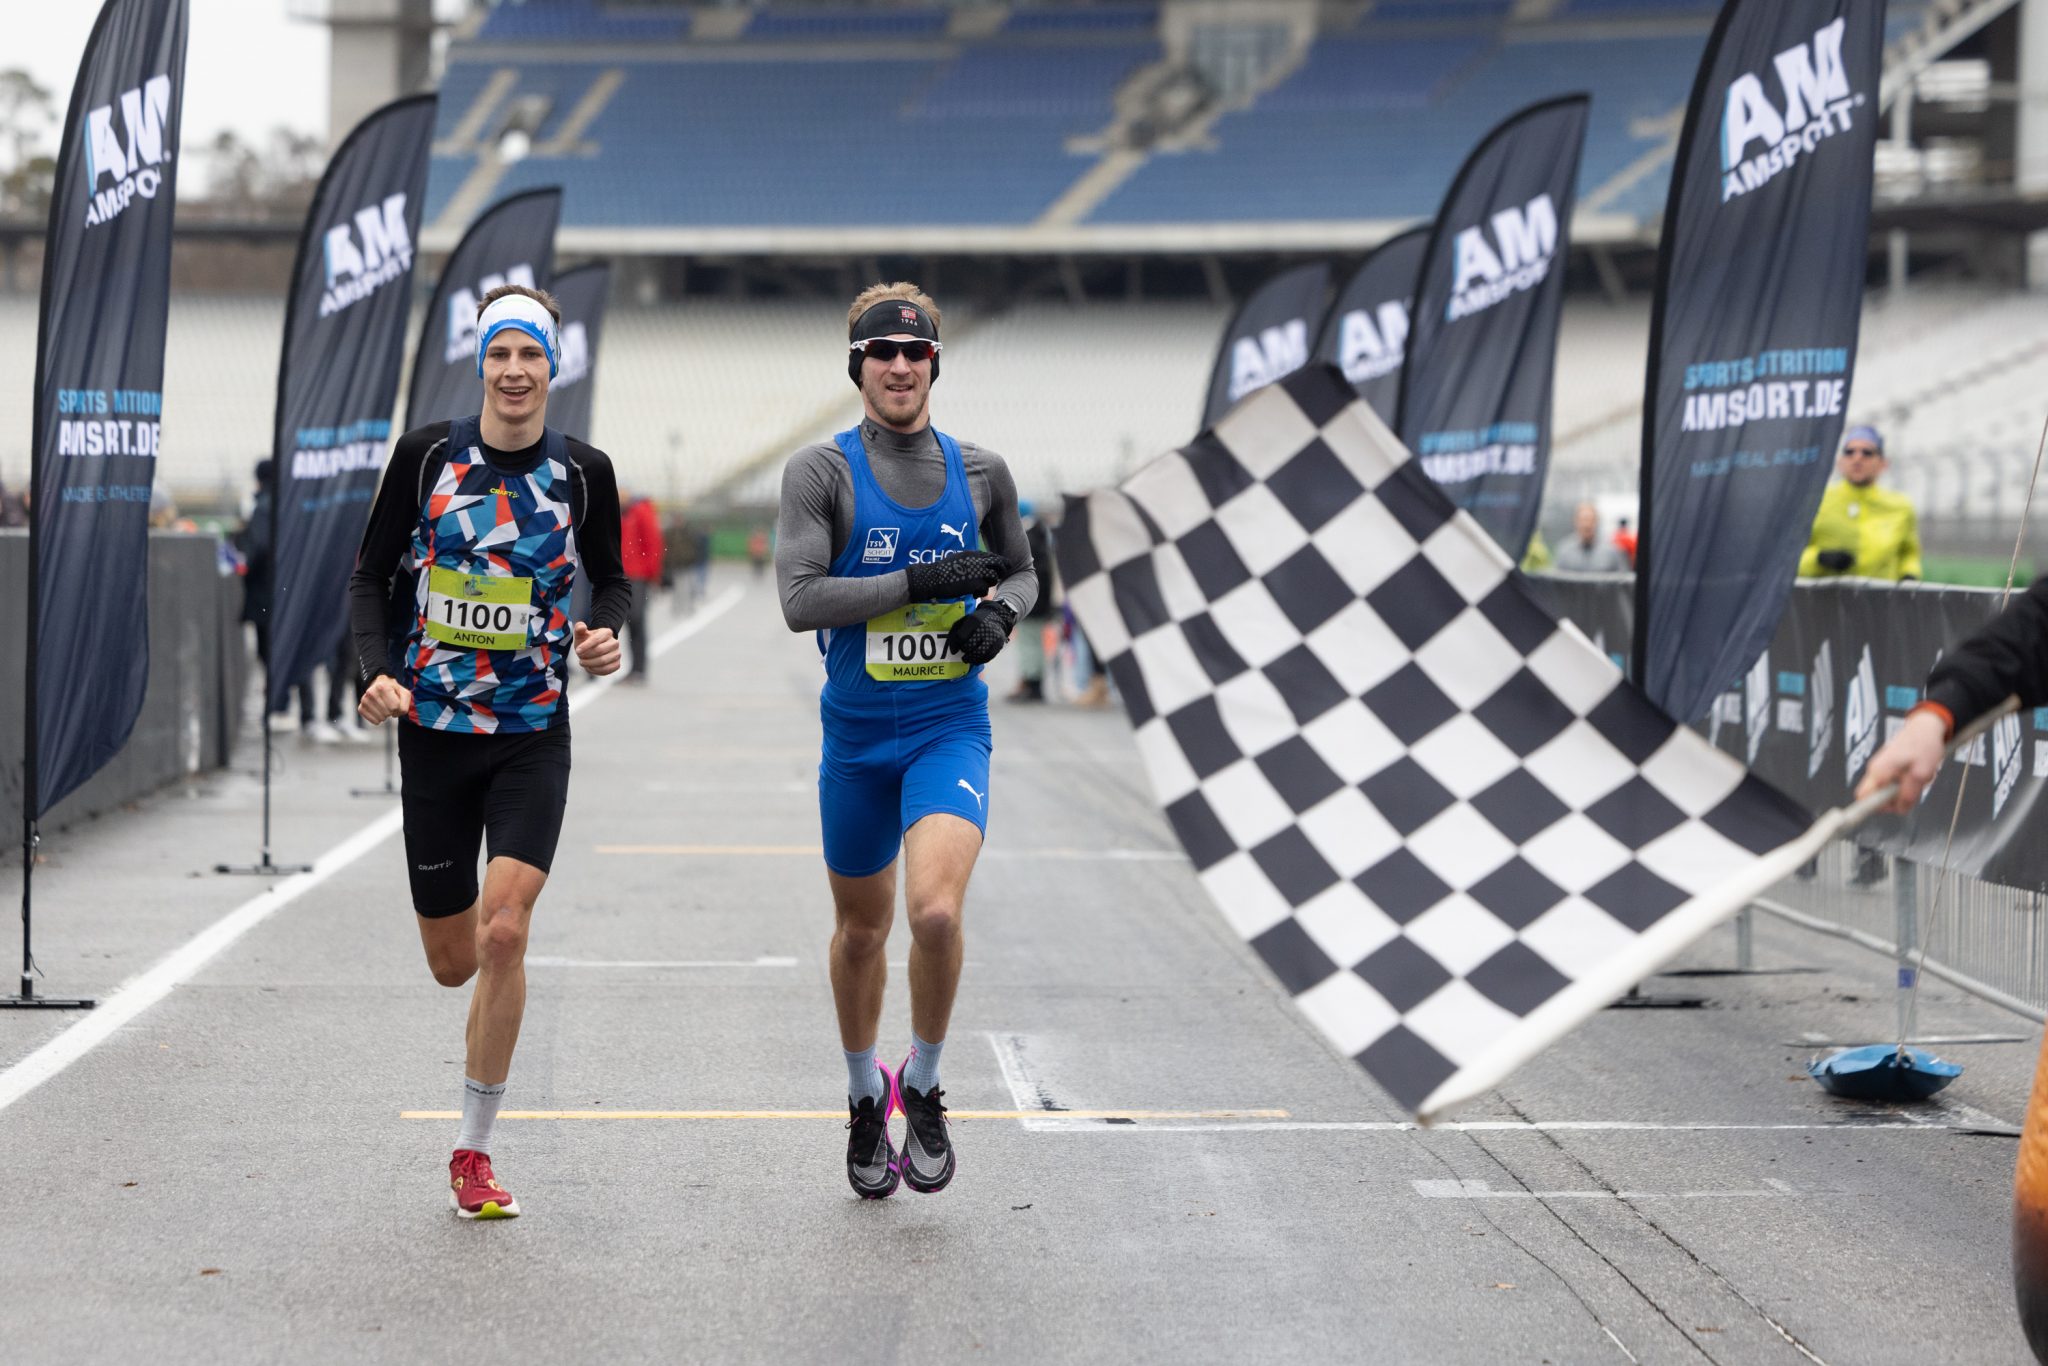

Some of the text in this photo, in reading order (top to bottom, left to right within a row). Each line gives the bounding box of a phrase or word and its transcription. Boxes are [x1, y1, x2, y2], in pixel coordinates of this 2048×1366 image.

[1720, 16, 1849, 173] AM
[84, 74, 171, 198] AM
[324, 191, 411, 290] AM
[1453, 192, 1557, 290] AM
[869, 540, 885, 548] TSV
[444, 599, 512, 632] 1100
[454, 632, 495, 645] ANTON
[883, 634, 950, 661] 1007
[893, 665, 945, 677] MAURICE
[418, 863, 445, 871] CRAFT
